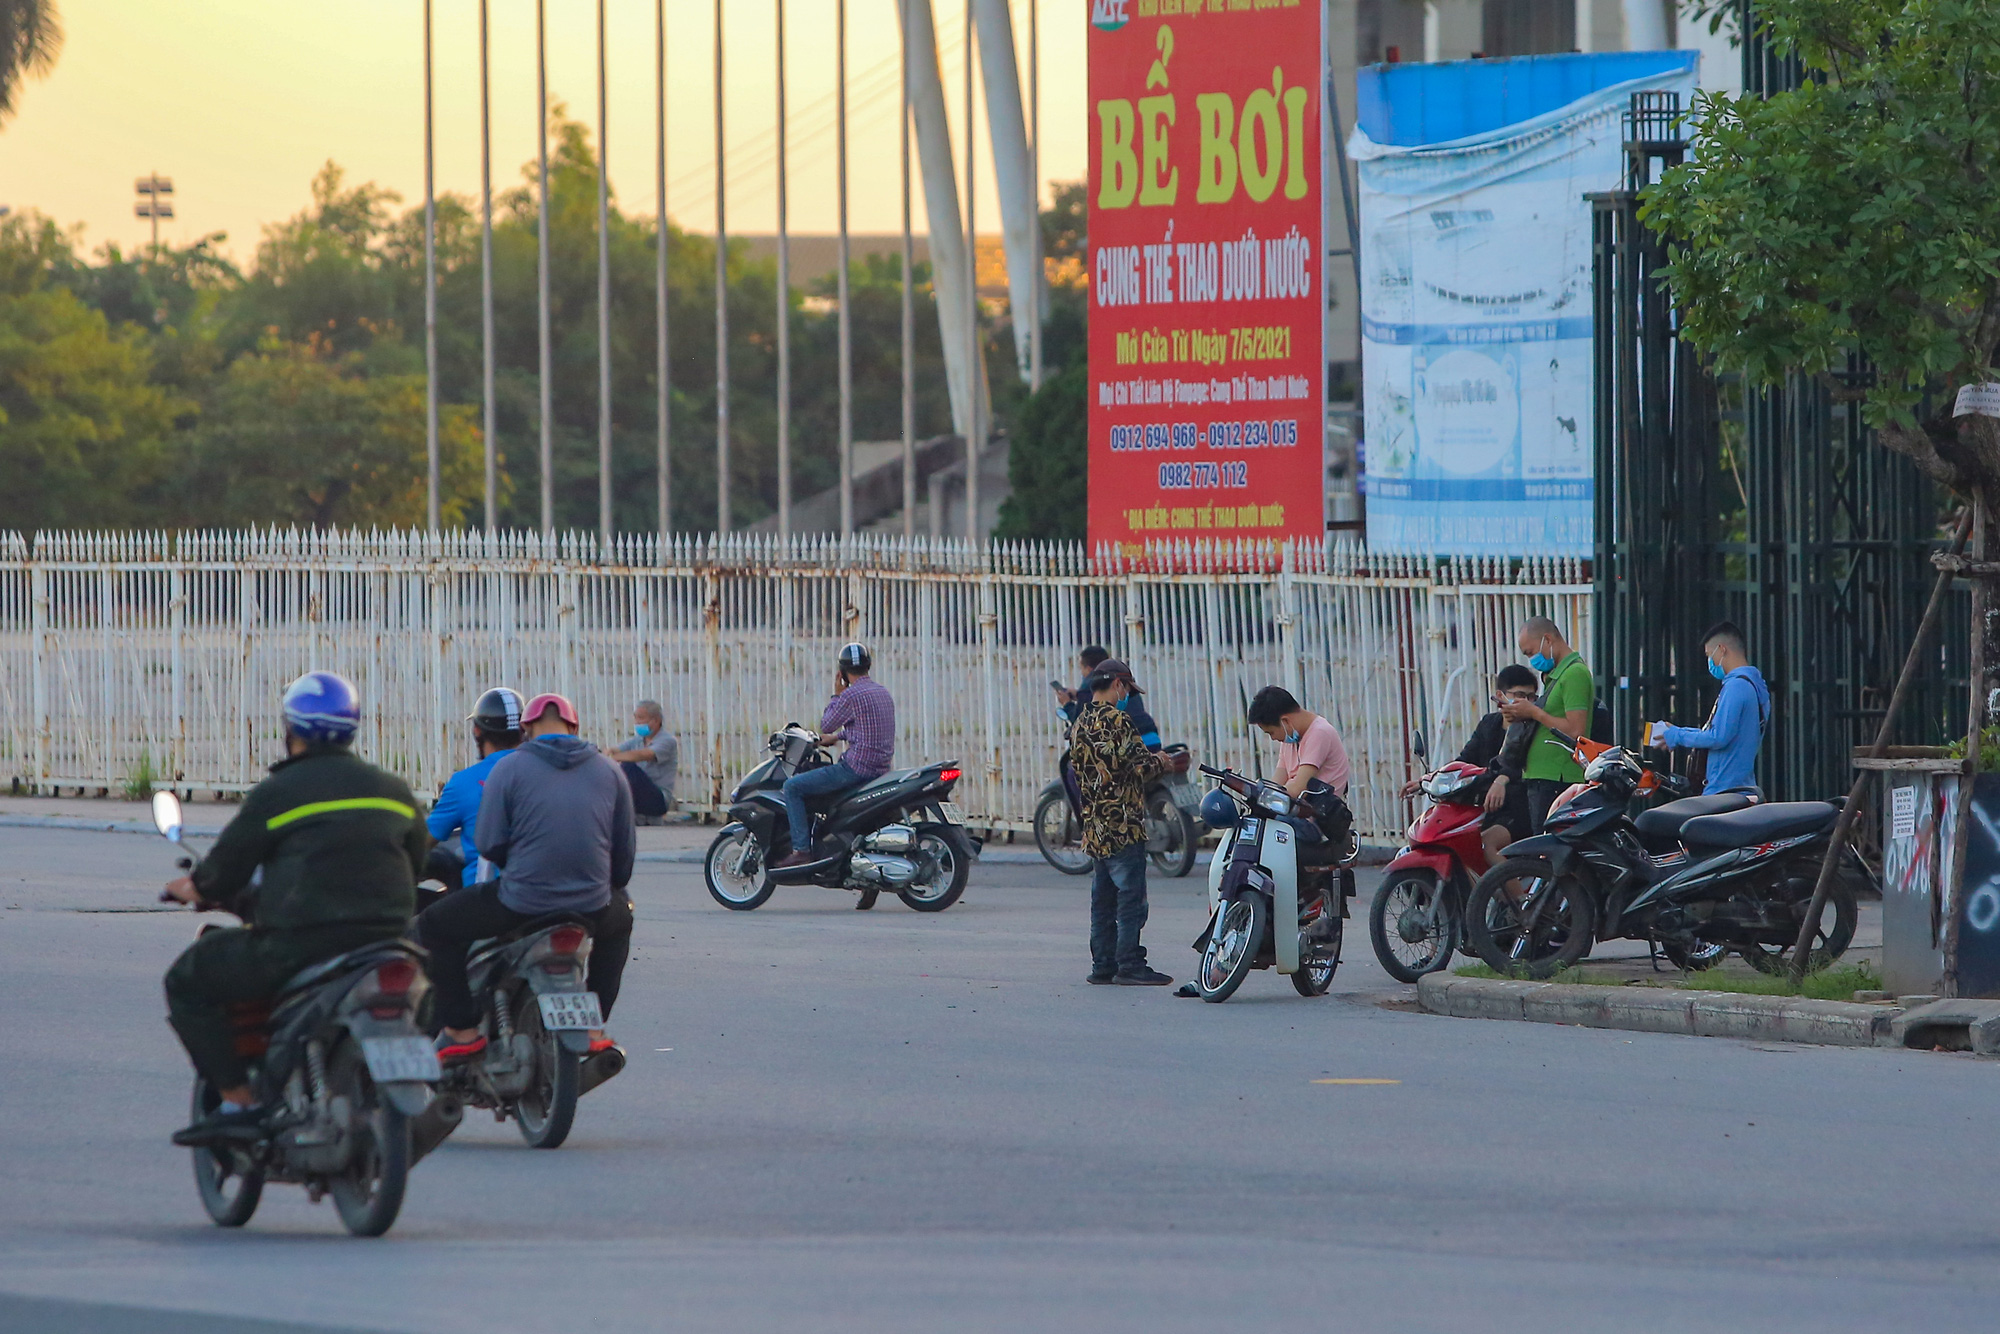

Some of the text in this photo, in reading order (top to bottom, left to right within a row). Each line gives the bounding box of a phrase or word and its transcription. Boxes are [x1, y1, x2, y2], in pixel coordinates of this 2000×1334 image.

[1097, 24, 1309, 210] BỂ BƠI
[1096, 218, 1311, 307] CUNG THỂ THAO DƯỚI NƯỚC
[1116, 326, 1291, 366] Mở Cửa Từ Ngày 7/5/2021
[1110, 423, 1142, 451] 0912
[1145, 423, 1169, 450] 694
[1172, 422, 1197, 449] 968
[1208, 421, 1242, 450] 0912
[1244, 421, 1268, 448] 234
[1272, 419, 1297, 447] 015
[1159, 460, 1247, 489] 0982 774 112
